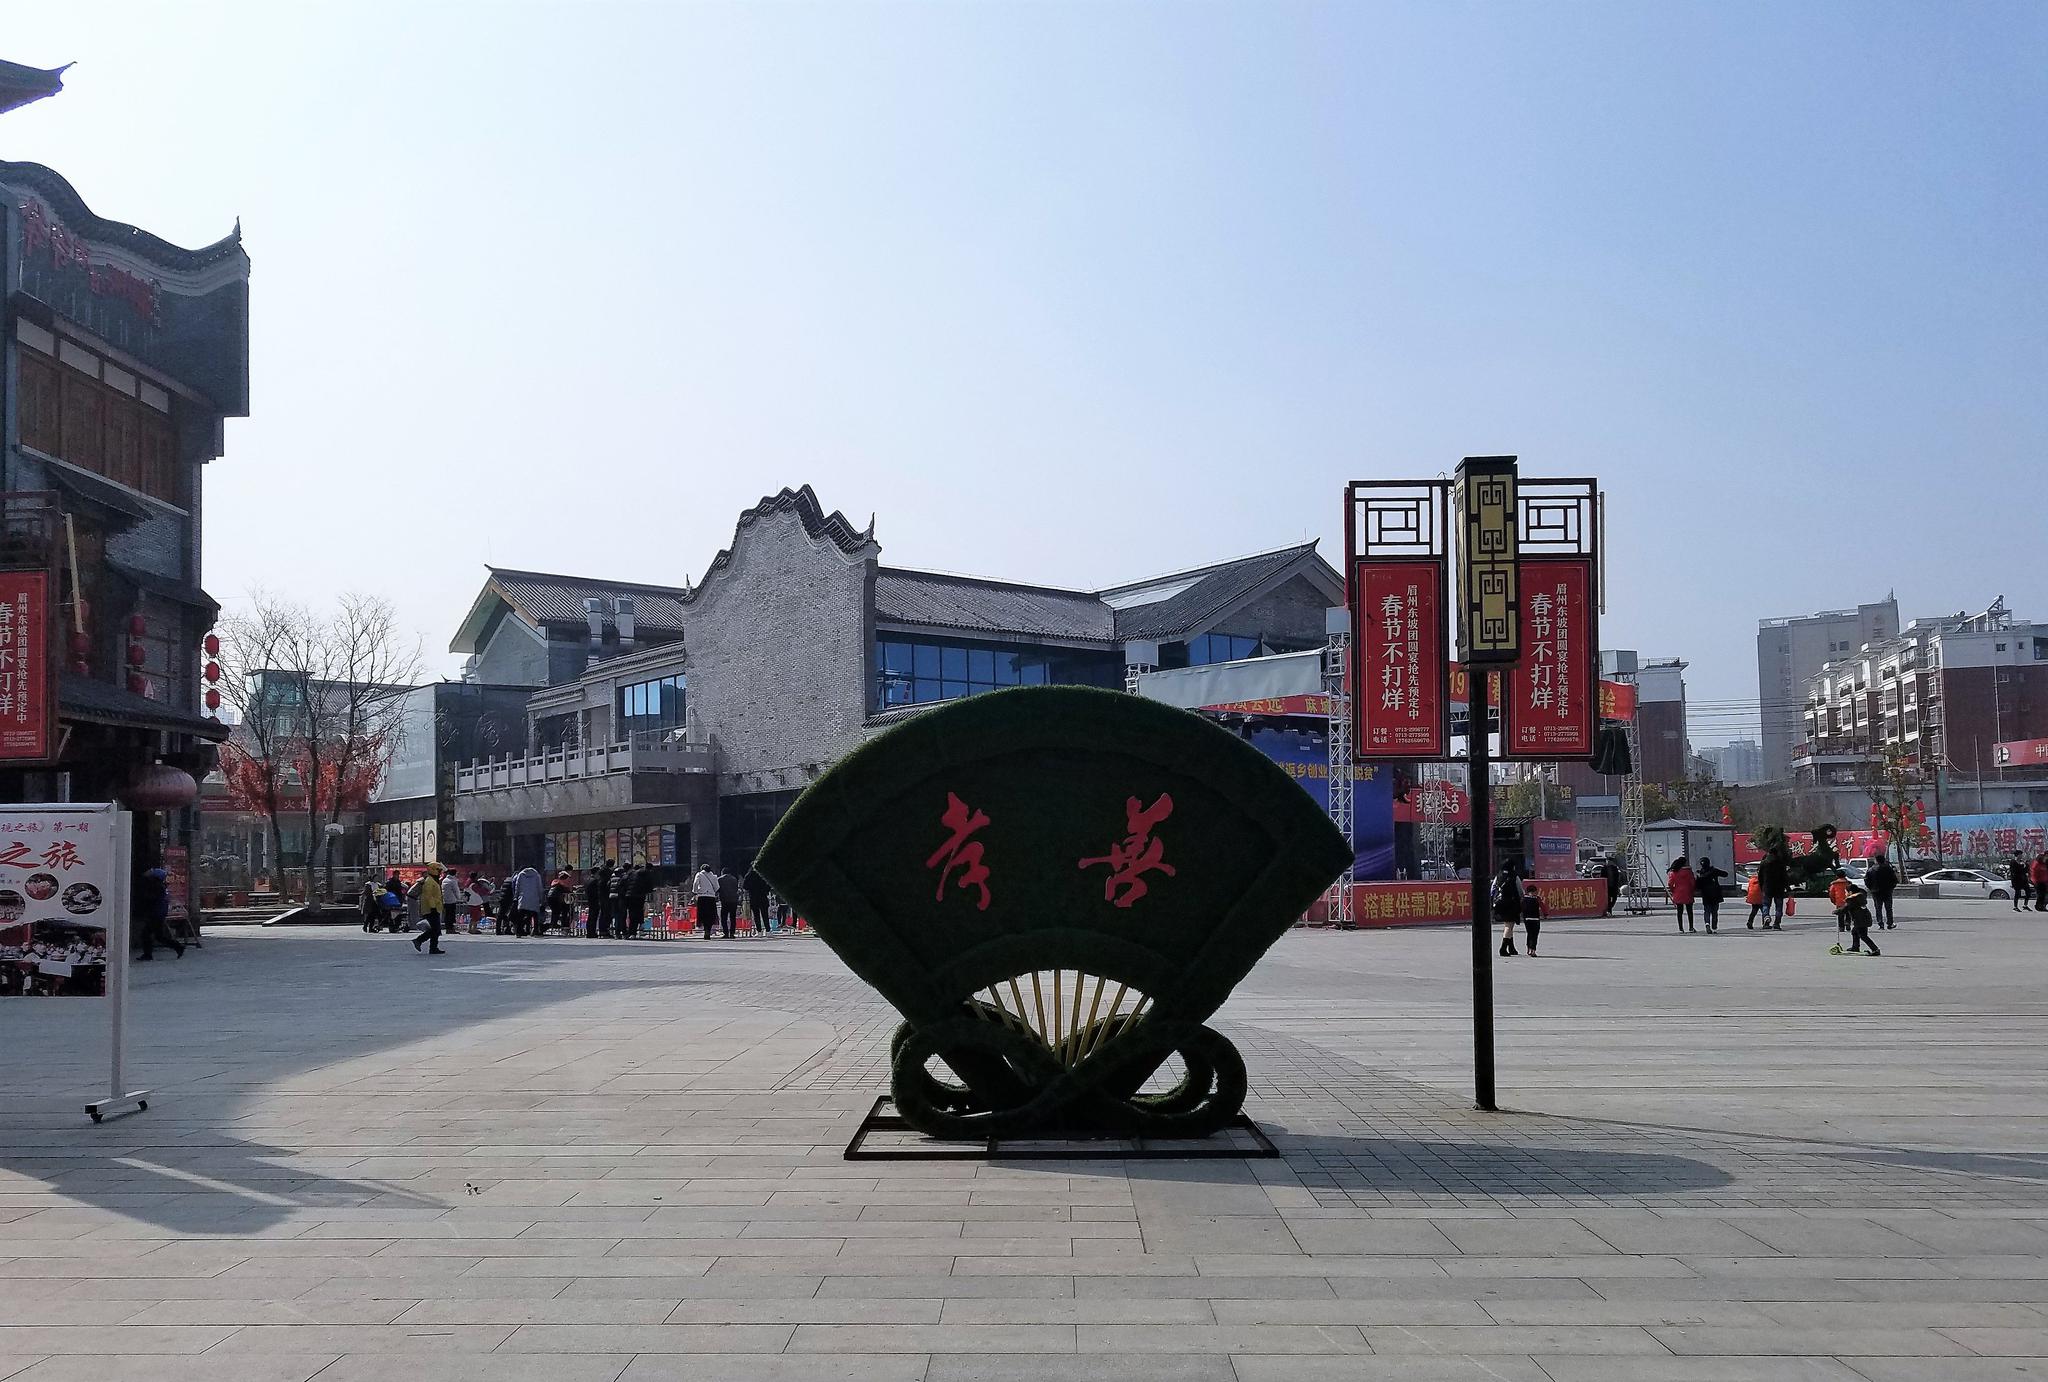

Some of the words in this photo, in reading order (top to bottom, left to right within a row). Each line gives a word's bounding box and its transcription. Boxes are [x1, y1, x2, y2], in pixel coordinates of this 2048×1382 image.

[17, 592, 28, 724] 眉州东坡团圆宴抢先预定中
[1380, 593, 1405, 711] 春节不打烊
[1407, 584, 1420, 720] 眉州东坡团圆宴抢先预定中
[1530, 592, 1554, 710] 春节不打烊
[1556, 583, 1569, 719] 眉州东坡团圆宴抢先预定中
[53, 821, 89, 833] 第一期
